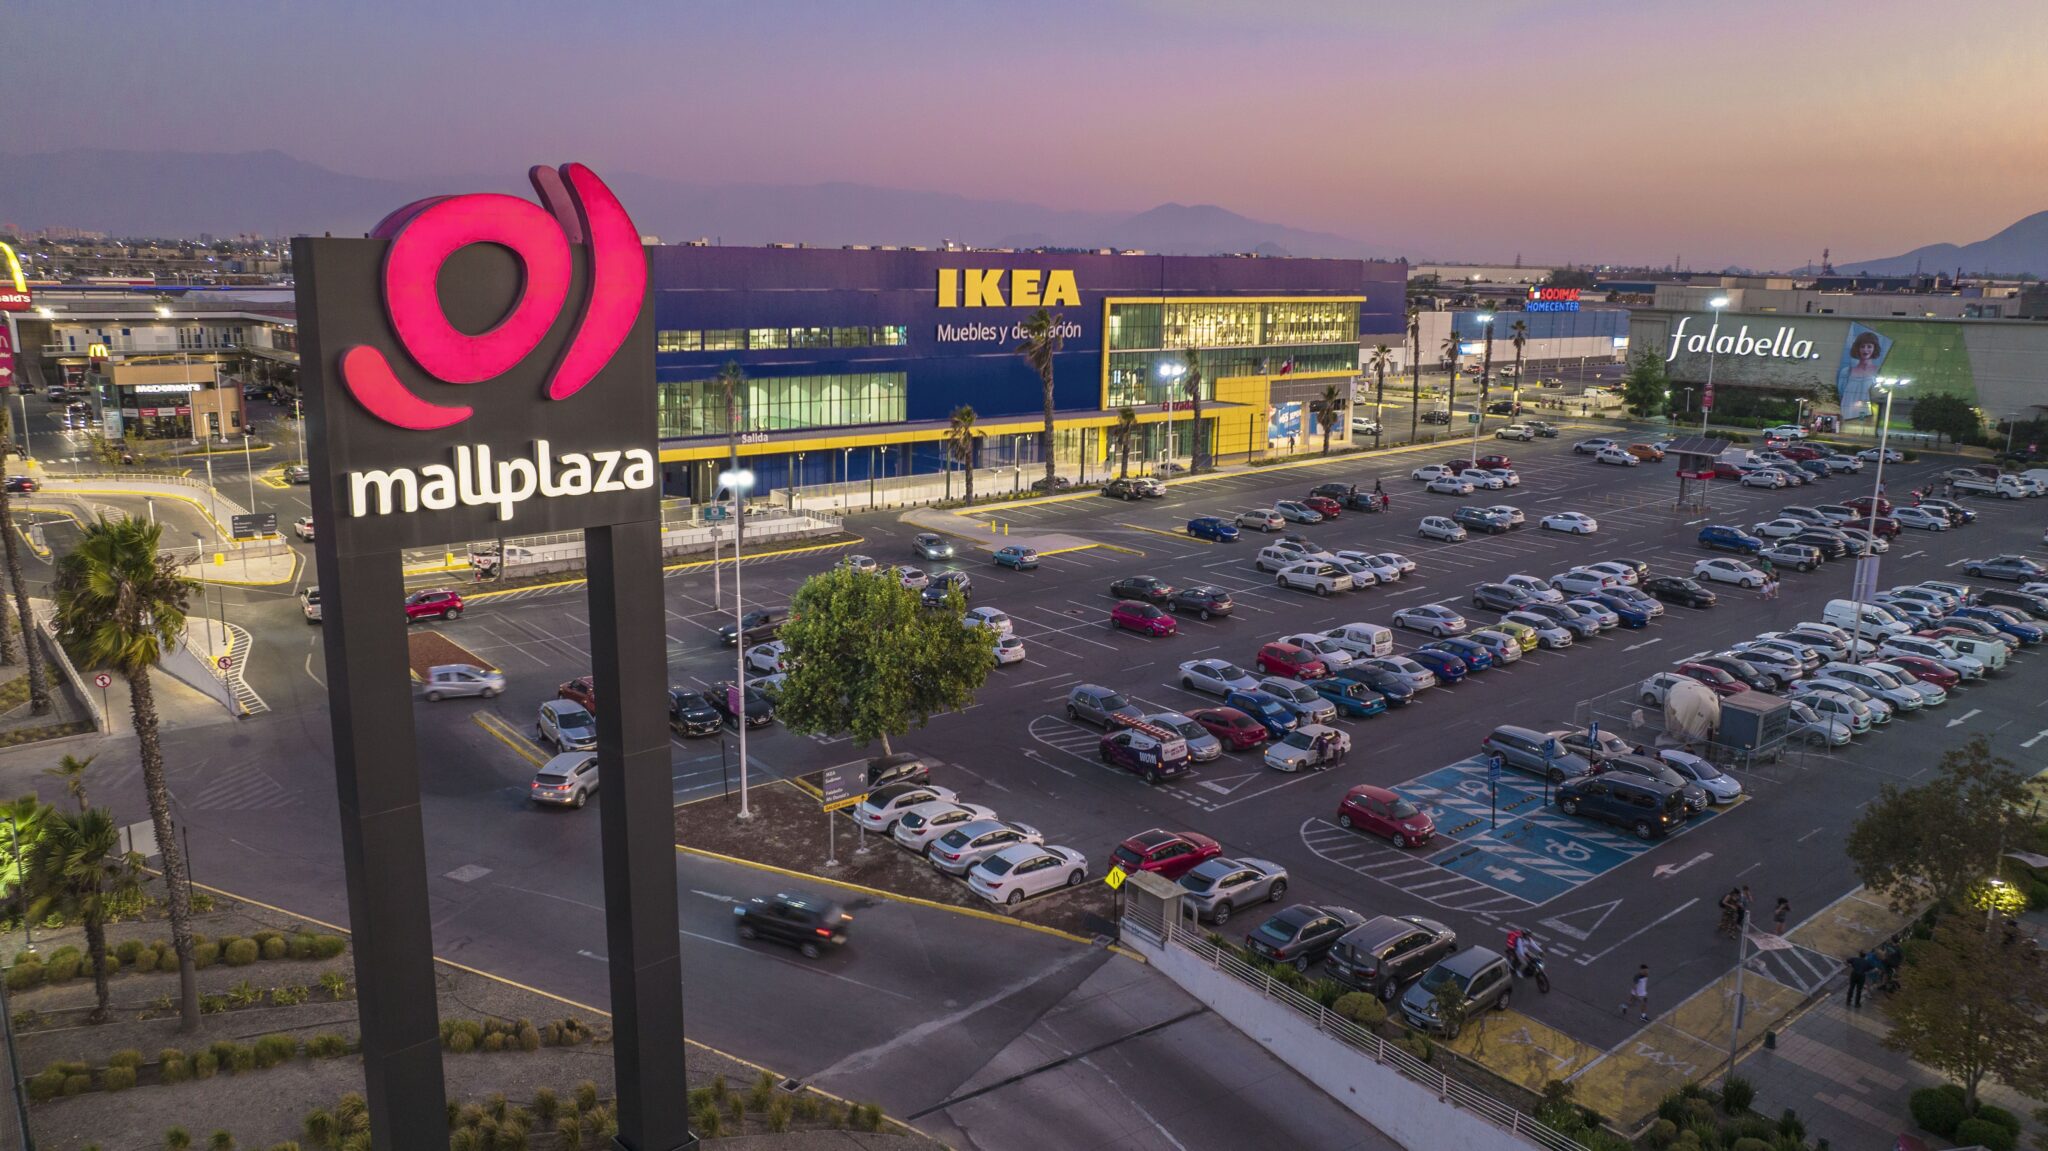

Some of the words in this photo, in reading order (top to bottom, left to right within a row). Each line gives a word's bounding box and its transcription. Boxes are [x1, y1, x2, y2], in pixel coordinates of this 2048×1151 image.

[938, 268, 1082, 307] IKEA
[1541, 288, 1581, 300] SODIMAC
[0, 294, 31, 303] ald's
[1527, 301, 1580, 312] HOMECENTER
[937, 322, 996, 342] Muebles
[999, 323, 1008, 345] y
[1012, 321, 1082, 340] deación
[741, 432, 769, 444] Salida
[348, 439, 654, 521] mallplaza
[1634, 1041, 1698, 1077] TAXI
